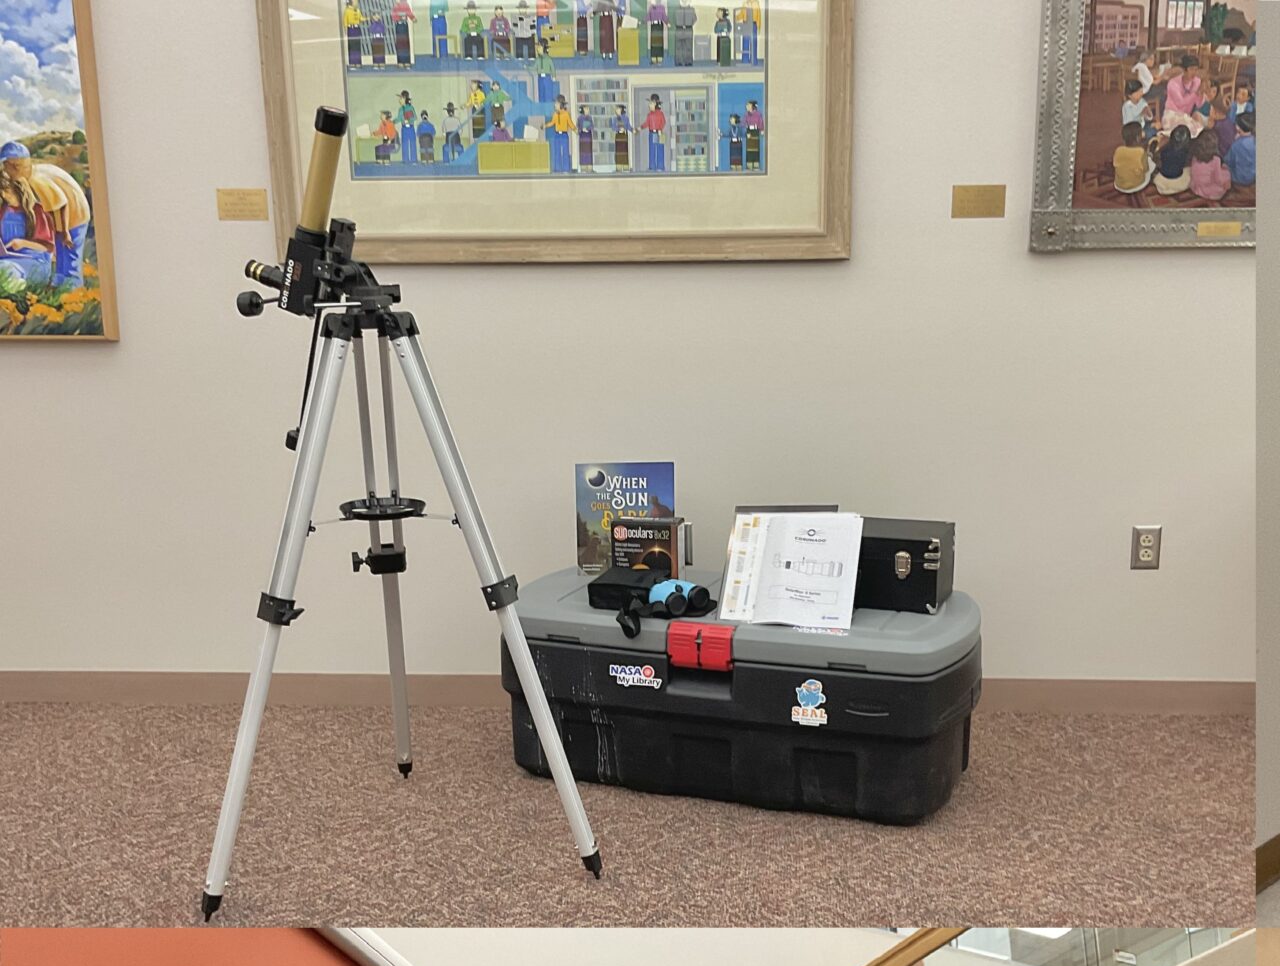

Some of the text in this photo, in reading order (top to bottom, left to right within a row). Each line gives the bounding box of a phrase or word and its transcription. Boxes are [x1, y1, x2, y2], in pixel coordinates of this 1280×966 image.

[606, 475, 647, 492] WHEN
[596, 489, 648, 510] THE SUN
[610, 666, 642, 676] NASA
[618, 676, 660, 687] My Library
[792, 707, 826, 719] SEAL
